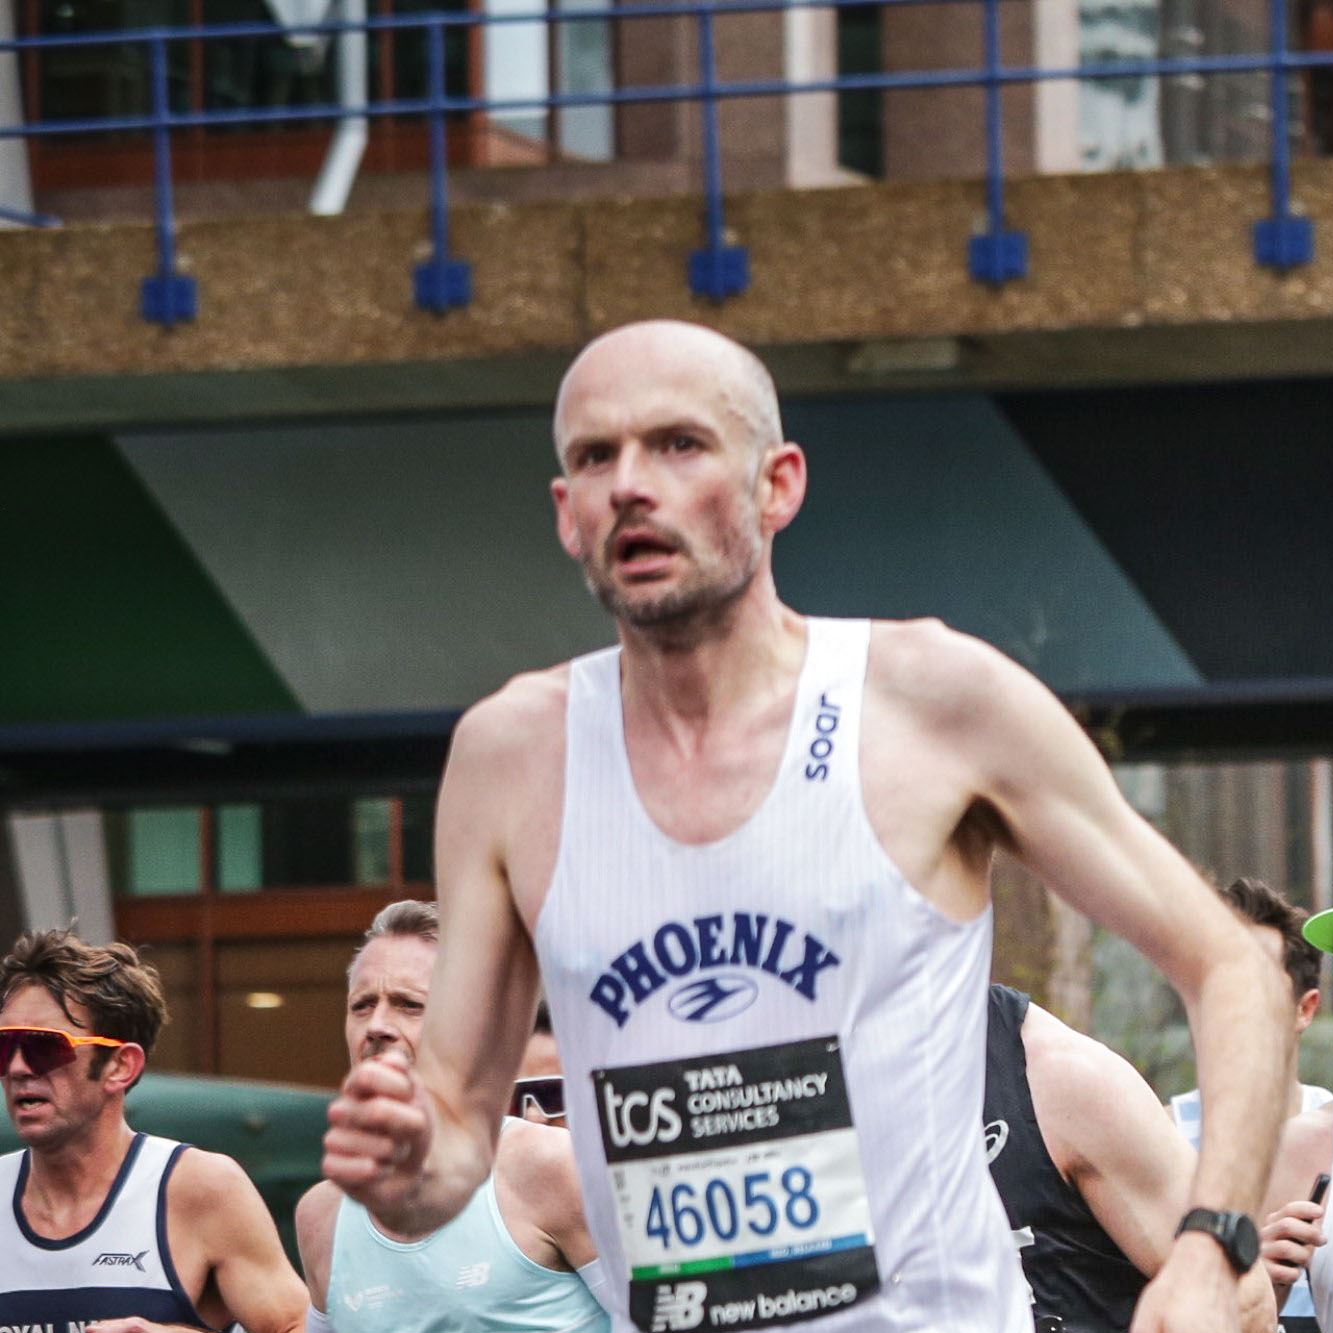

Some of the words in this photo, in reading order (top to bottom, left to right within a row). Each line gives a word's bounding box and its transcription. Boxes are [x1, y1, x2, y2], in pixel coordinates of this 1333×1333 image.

[806, 692, 841, 782] soar
[590, 912, 840, 1029] PHOENIX
[683, 1064, 743, 1092] TATA
[687, 1072, 828, 1115] CONSULTANCY
[604, 1083, 682, 1148] tcs
[690, 1106, 780, 1138] SERVICES
[646, 1166, 820, 1248] 46058
[93, 1250, 149, 1272] FASTRAX
[709, 1300, 757, 1325] new
[759, 1283, 857, 1319] balance
